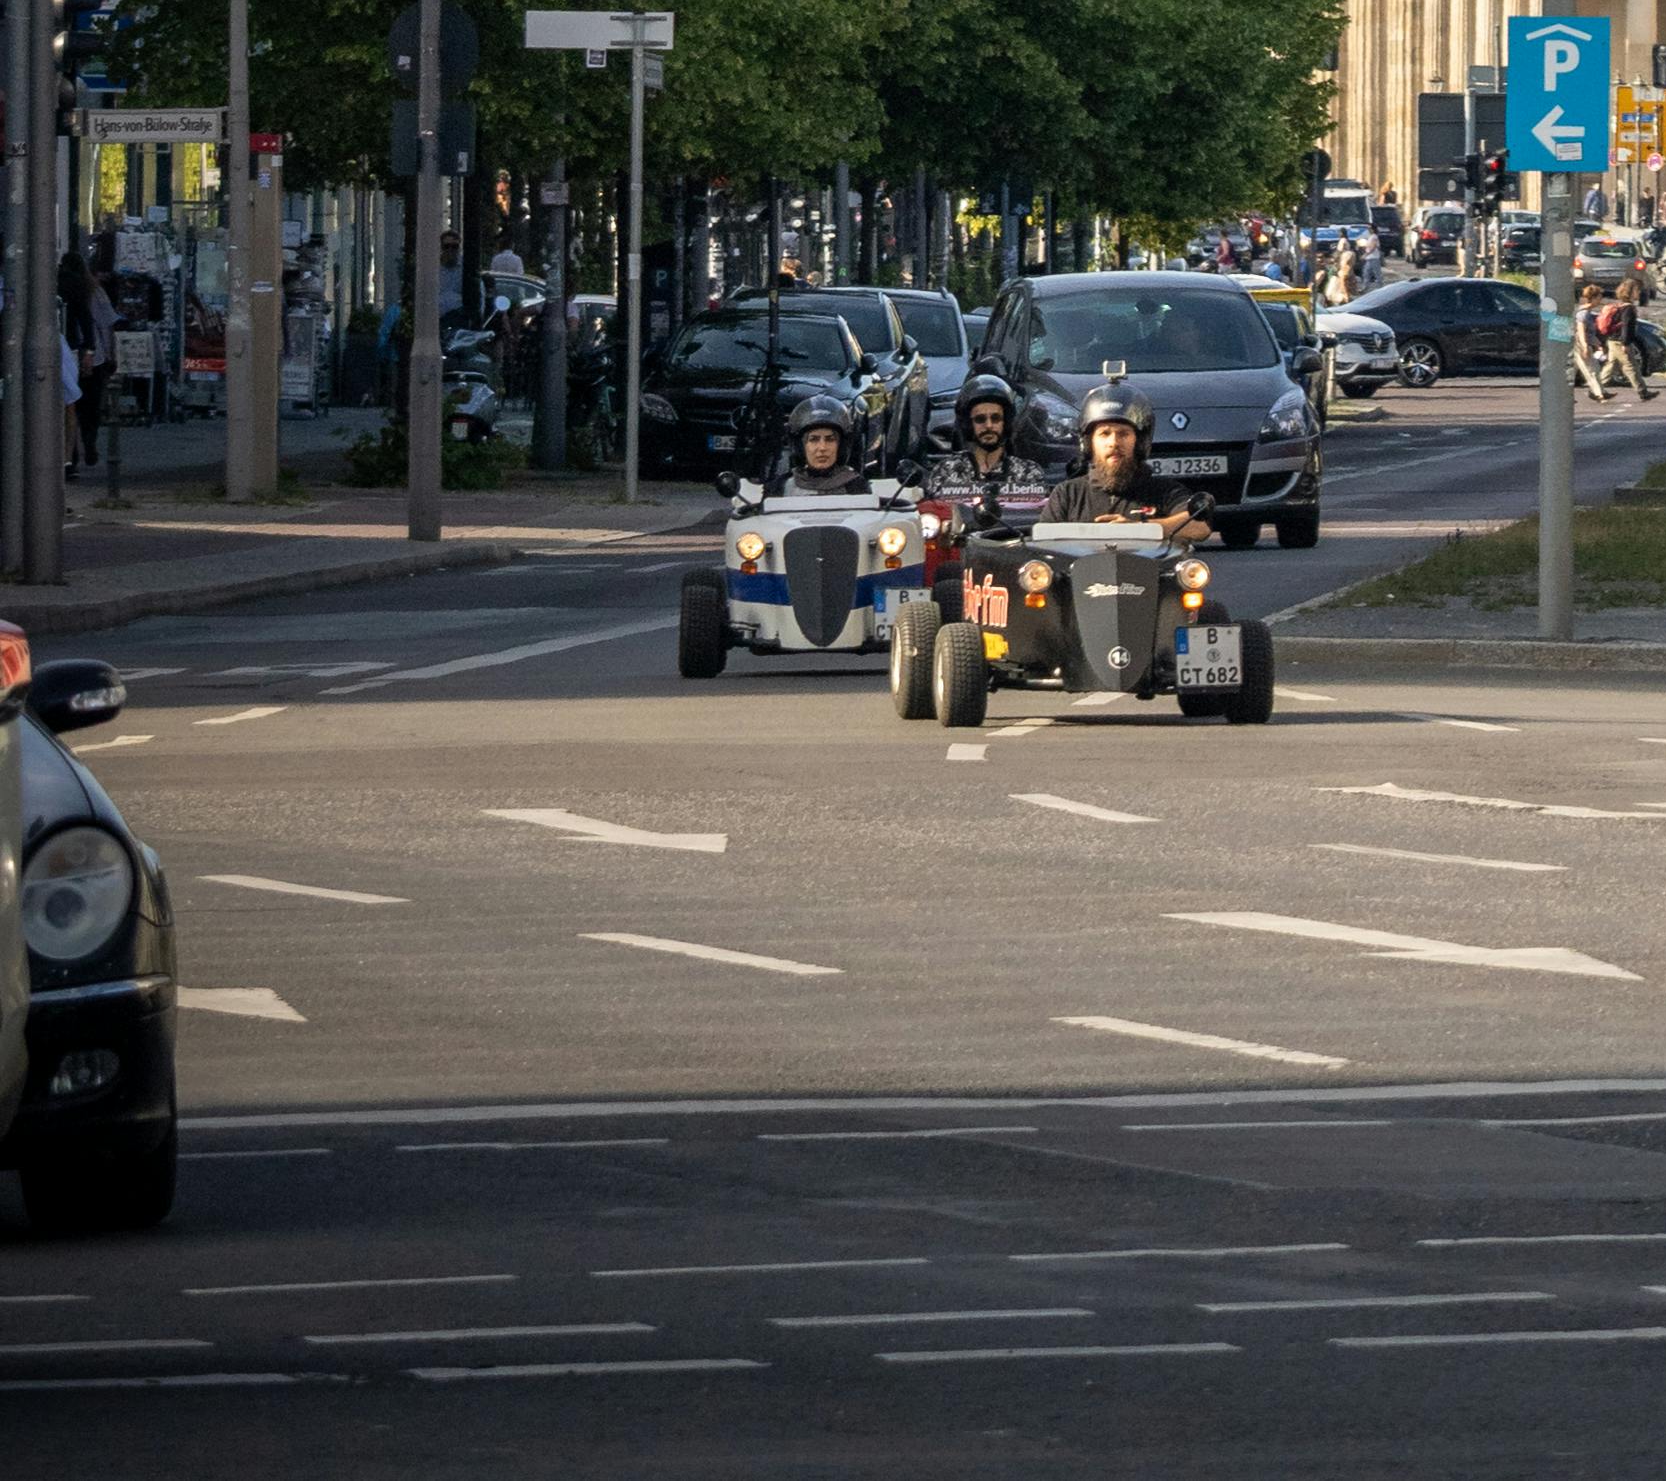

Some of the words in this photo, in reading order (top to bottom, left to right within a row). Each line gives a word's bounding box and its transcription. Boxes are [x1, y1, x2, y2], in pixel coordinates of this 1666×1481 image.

[1543, 40, 1580, 91] P
[942, 483, 1044, 495] www.hod.berlin
[1207, 627, 1218, 644] B
[1180, 667, 1202, 684] CT
[1206, 666, 1239, 684] 682
